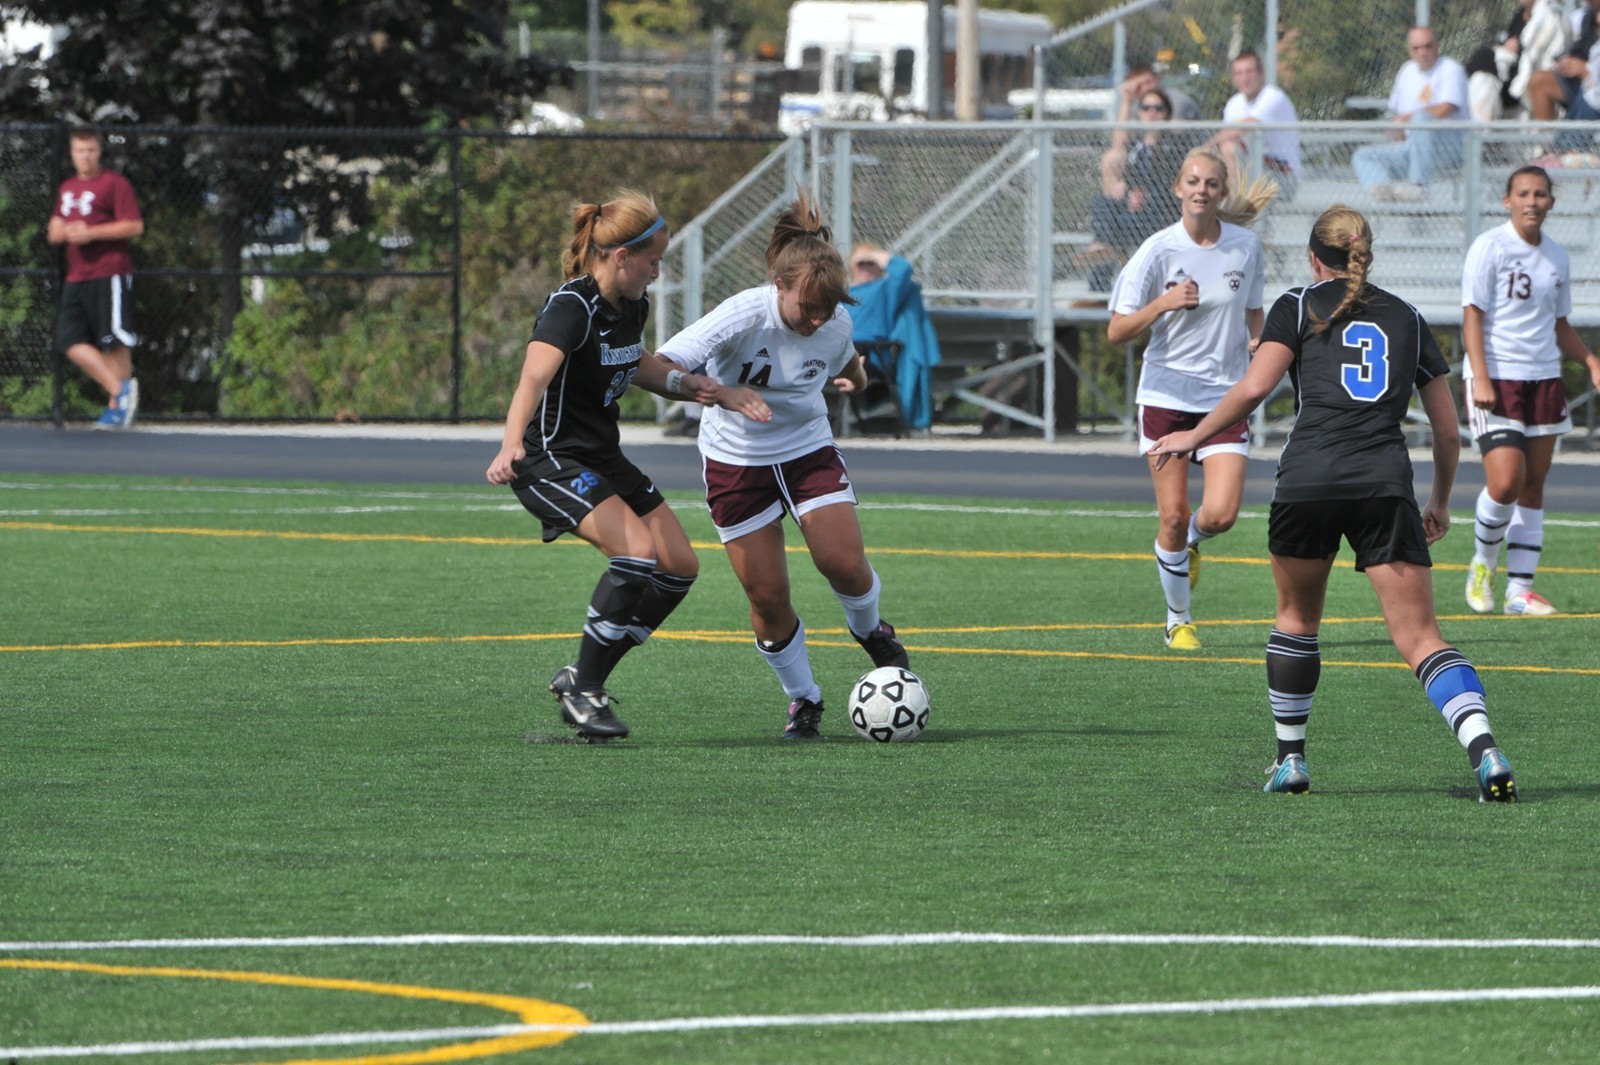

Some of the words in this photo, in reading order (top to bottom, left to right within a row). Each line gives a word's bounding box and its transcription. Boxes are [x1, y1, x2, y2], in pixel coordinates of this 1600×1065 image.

[1507, 271, 1531, 300] 13
[738, 361, 772, 388] 14
[802, 359, 827, 370] PANTHERS
[1341, 321, 1389, 402] 3
[570, 471, 599, 495] 25
